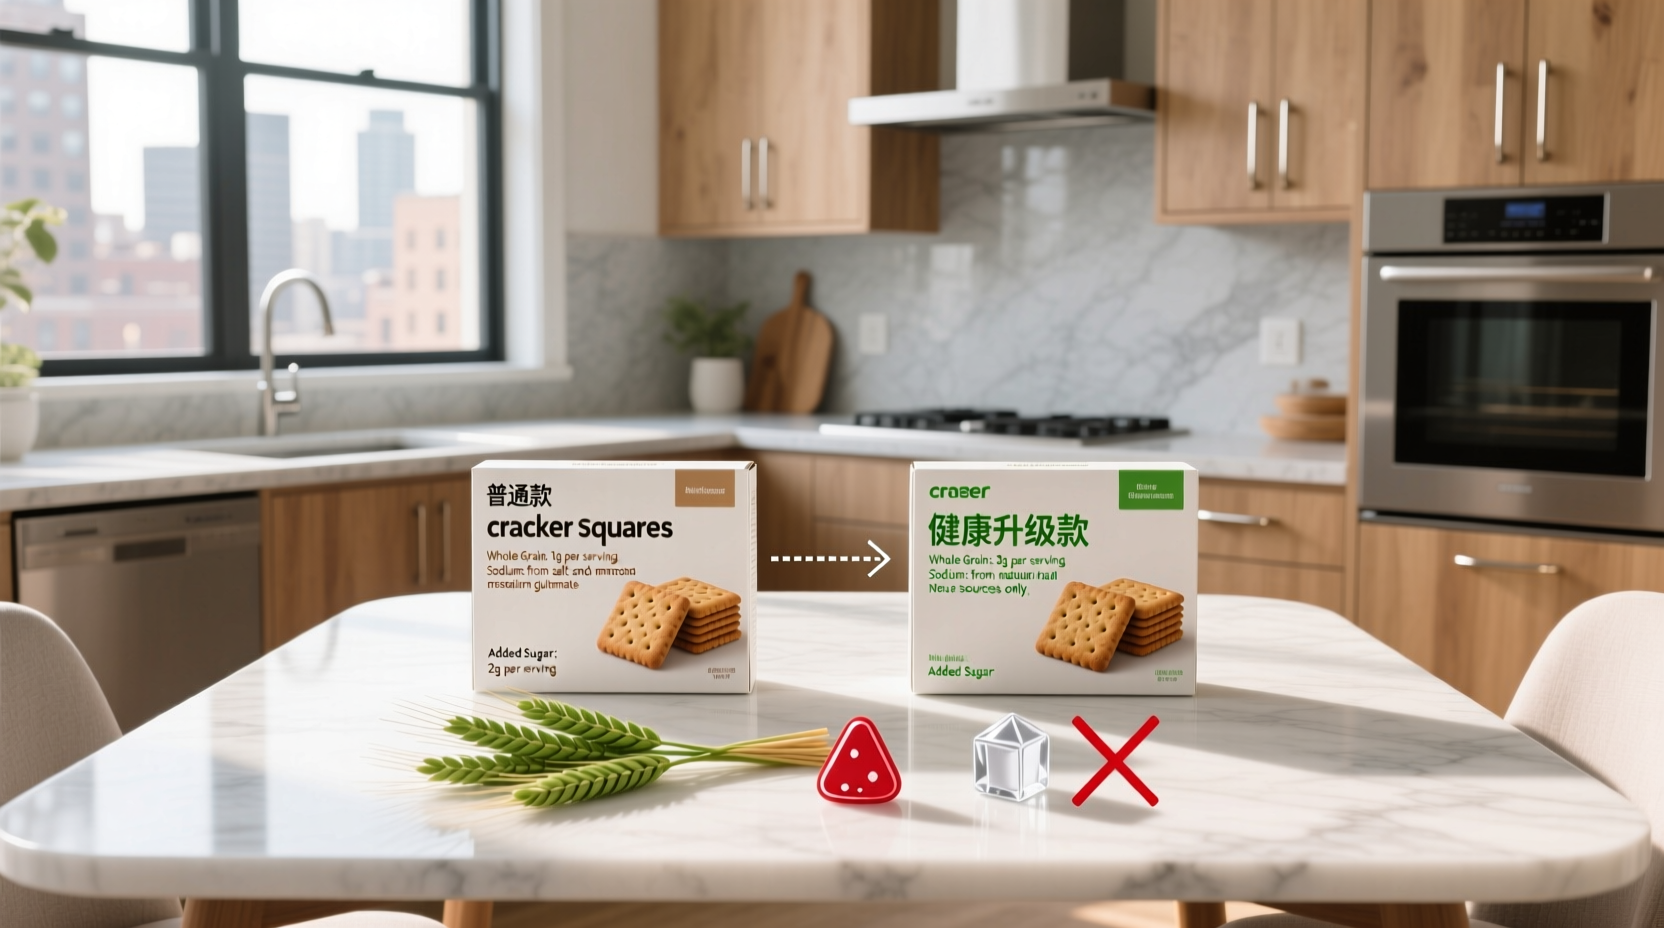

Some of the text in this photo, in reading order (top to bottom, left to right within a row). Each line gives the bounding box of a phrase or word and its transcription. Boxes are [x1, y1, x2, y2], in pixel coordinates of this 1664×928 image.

[487, 483, 552, 508] 普通款
[487, 514, 573, 538] cracker
[928, 512, 1089, 547] 健康升级款
[487, 550, 518, 561] Whole
[565, 553, 579, 564] per
[996, 554, 1008, 568] 3g
[488, 646, 522, 658] Added
[488, 663, 501, 677] 2g
[504, 666, 521, 677] per
[928, 664, 962, 676] Added
